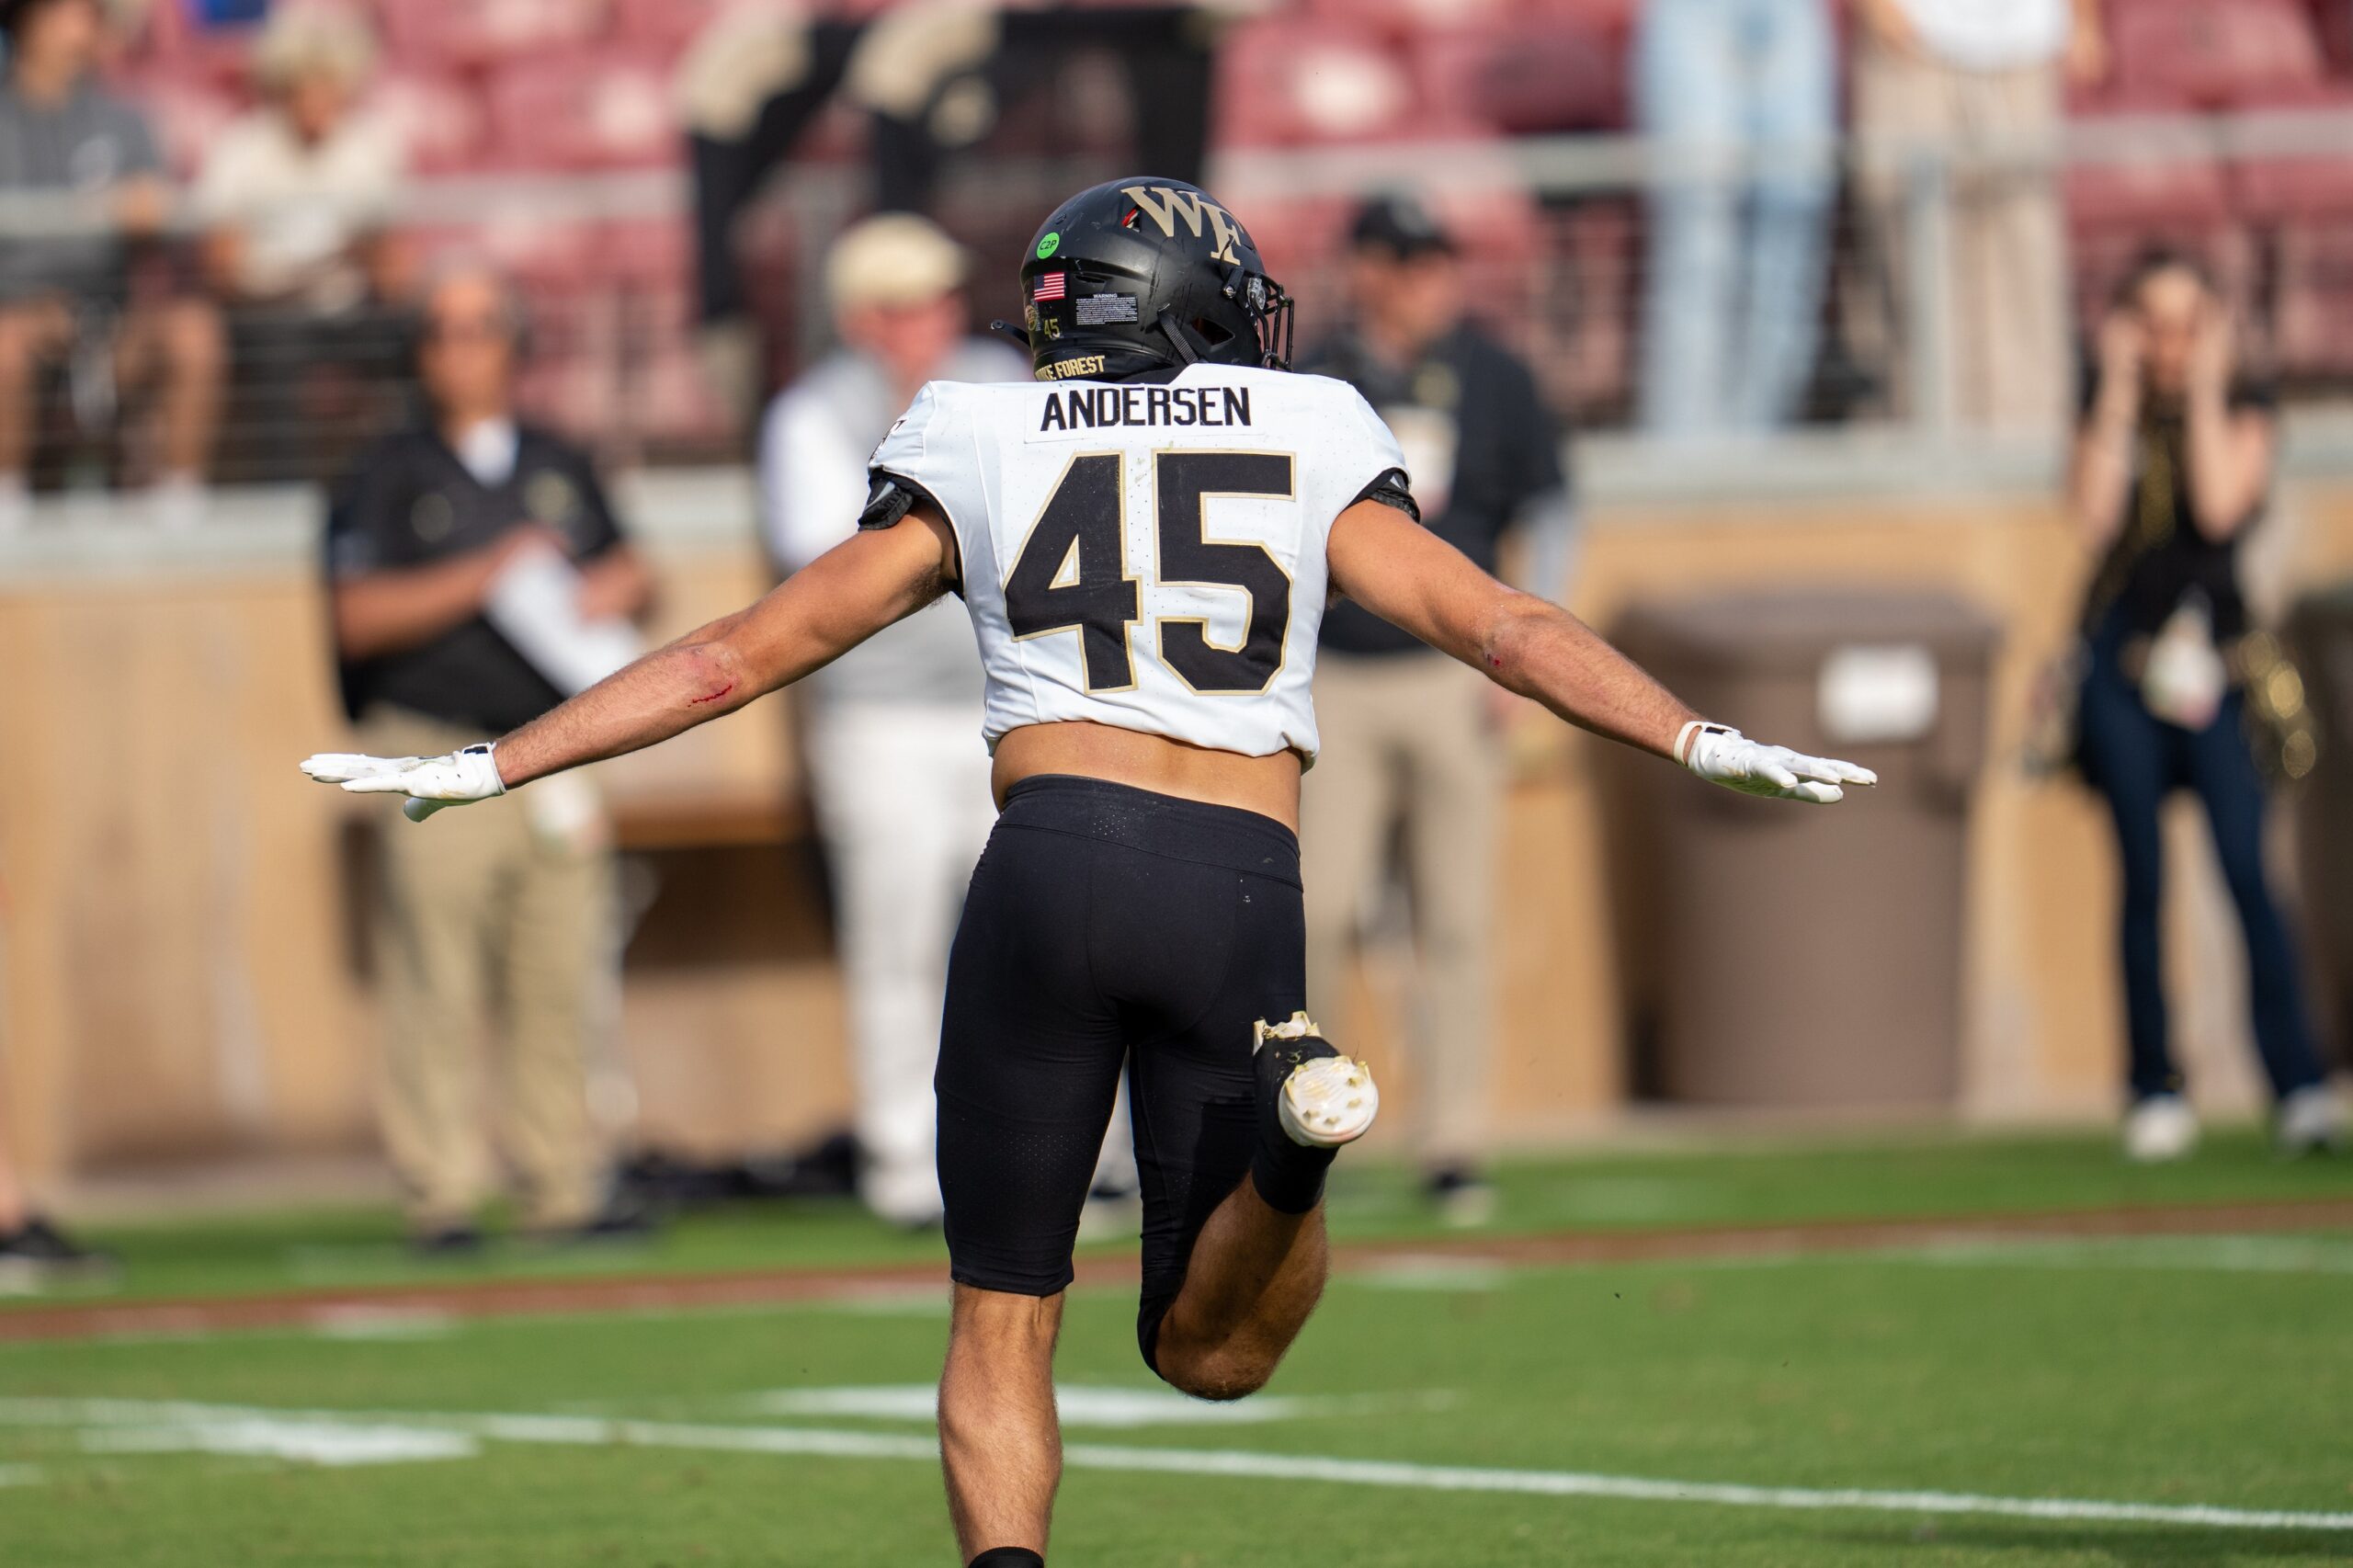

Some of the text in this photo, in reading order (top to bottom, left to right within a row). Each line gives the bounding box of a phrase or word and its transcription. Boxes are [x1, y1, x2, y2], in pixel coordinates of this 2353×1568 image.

[1120, 186, 1244, 266] WF
[1040, 239, 1057, 250] C2P
[1044, 318, 1061, 339] 45
[1053, 355, 1106, 380] FOREST
[1040, 387, 1251, 431] ANDERSEN
[1002, 448, 1296, 696] 45
